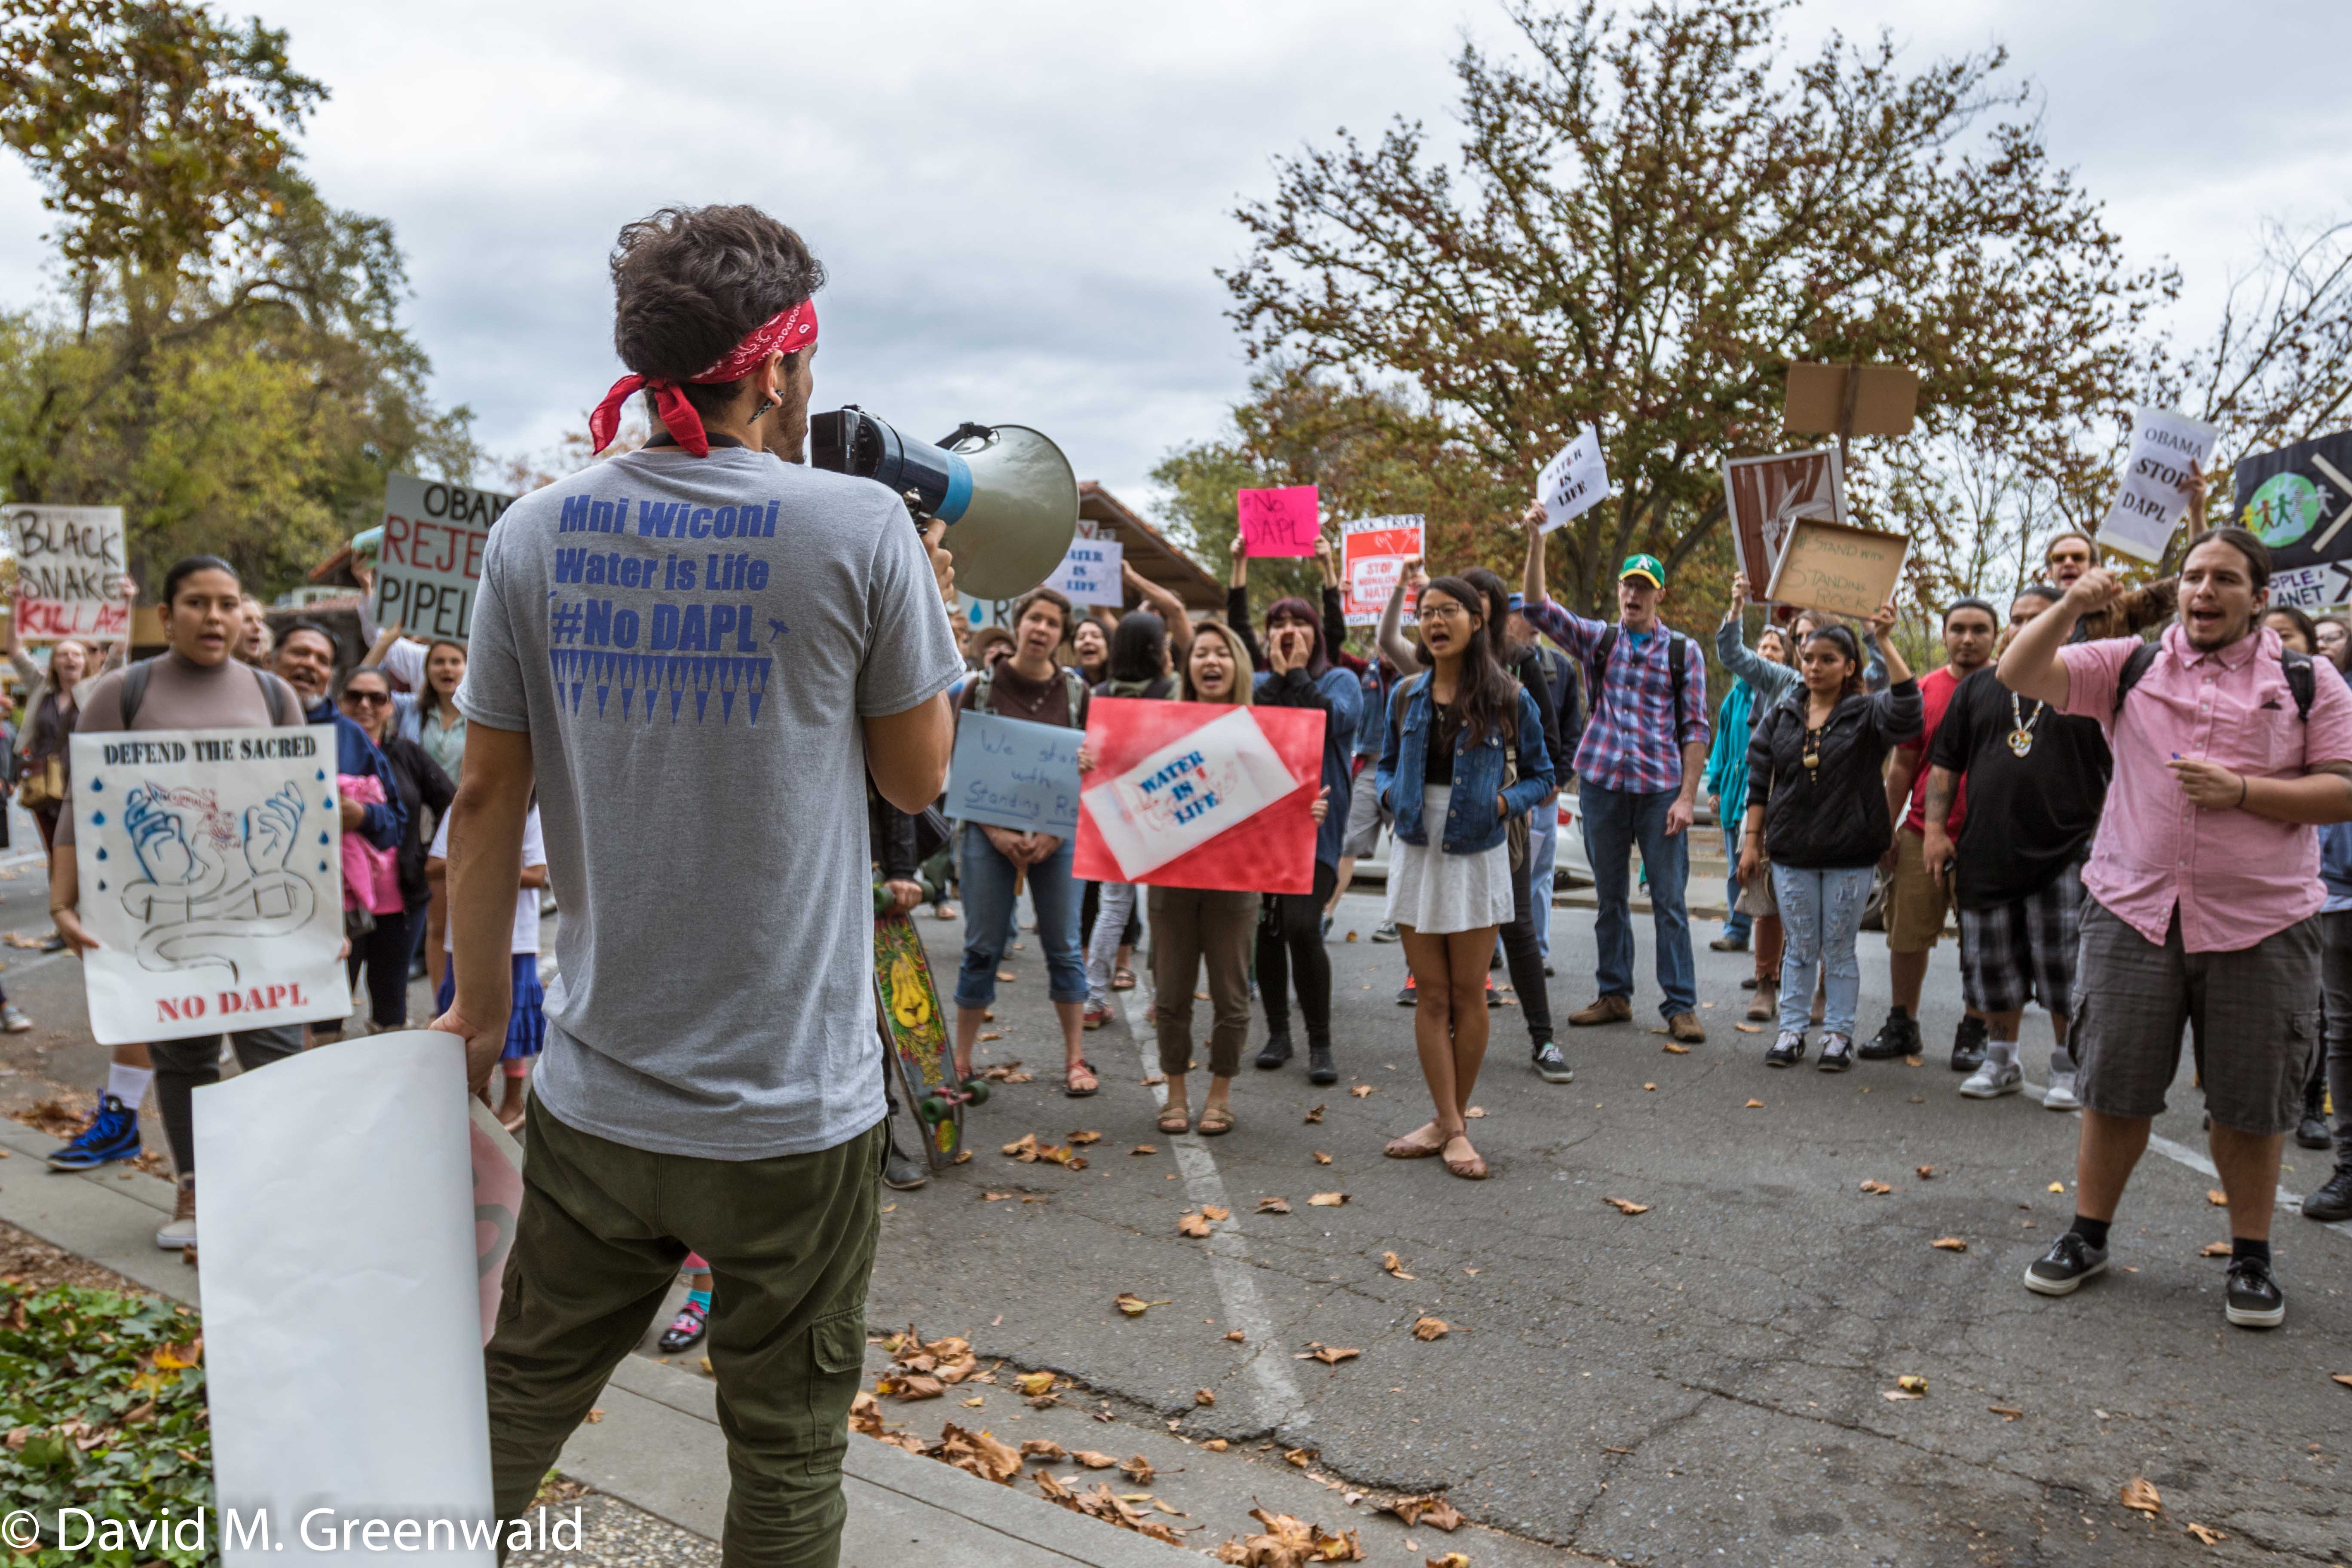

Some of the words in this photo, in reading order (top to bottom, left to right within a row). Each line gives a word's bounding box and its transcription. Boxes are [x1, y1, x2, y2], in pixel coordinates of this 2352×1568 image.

[2145, 427, 2202, 458] OBAMA
[1560, 472, 1571, 487] IS
[2136, 457, 2190, 488] STOP
[423, 484, 511, 528] OBAM
[1558, 480, 1587, 506] LIFE
[2122, 492, 2165, 524] DAPL
[560, 494, 629, 534] Mni
[638, 500, 780, 539] Wiconi
[1245, 518, 1311, 546] DAPL
[12, 510, 120, 567] BLACK
[383, 514, 489, 579] REJE
[556, 548, 658, 589] Water
[665, 554, 697, 591] is
[705, 553, 769, 591] Life
[1068, 549, 1104, 561] ATER
[1073, 565, 1086, 576] IS
[1367, 562, 1393, 575] STOP
[18, 566, 125, 601] SNAKE
[1067, 580, 1098, 591] LIFE
[2278, 585, 2324, 606] ANET
[17, 600, 127, 634] KILLAZ
[377, 575, 472, 639] PIPEL
[552, 599, 640, 649] #No
[651, 603, 757, 652] DAPL
[104, 741, 186, 765] DEFEND
[192, 738, 234, 762] THE
[240, 735, 316, 760] SACRED
[981, 730, 1012, 755] We
[1038, 741, 1077, 763] stan
[1011, 768, 1051, 788] with
[1140, 751, 1205, 794] WATER
[965, 780, 1041, 817] Standing
[1172, 781, 1194, 800] IS
[1174, 790, 1219, 825] LIFE
[155, 995, 205, 1023] NO
[217, 982, 309, 1015] DAPL
